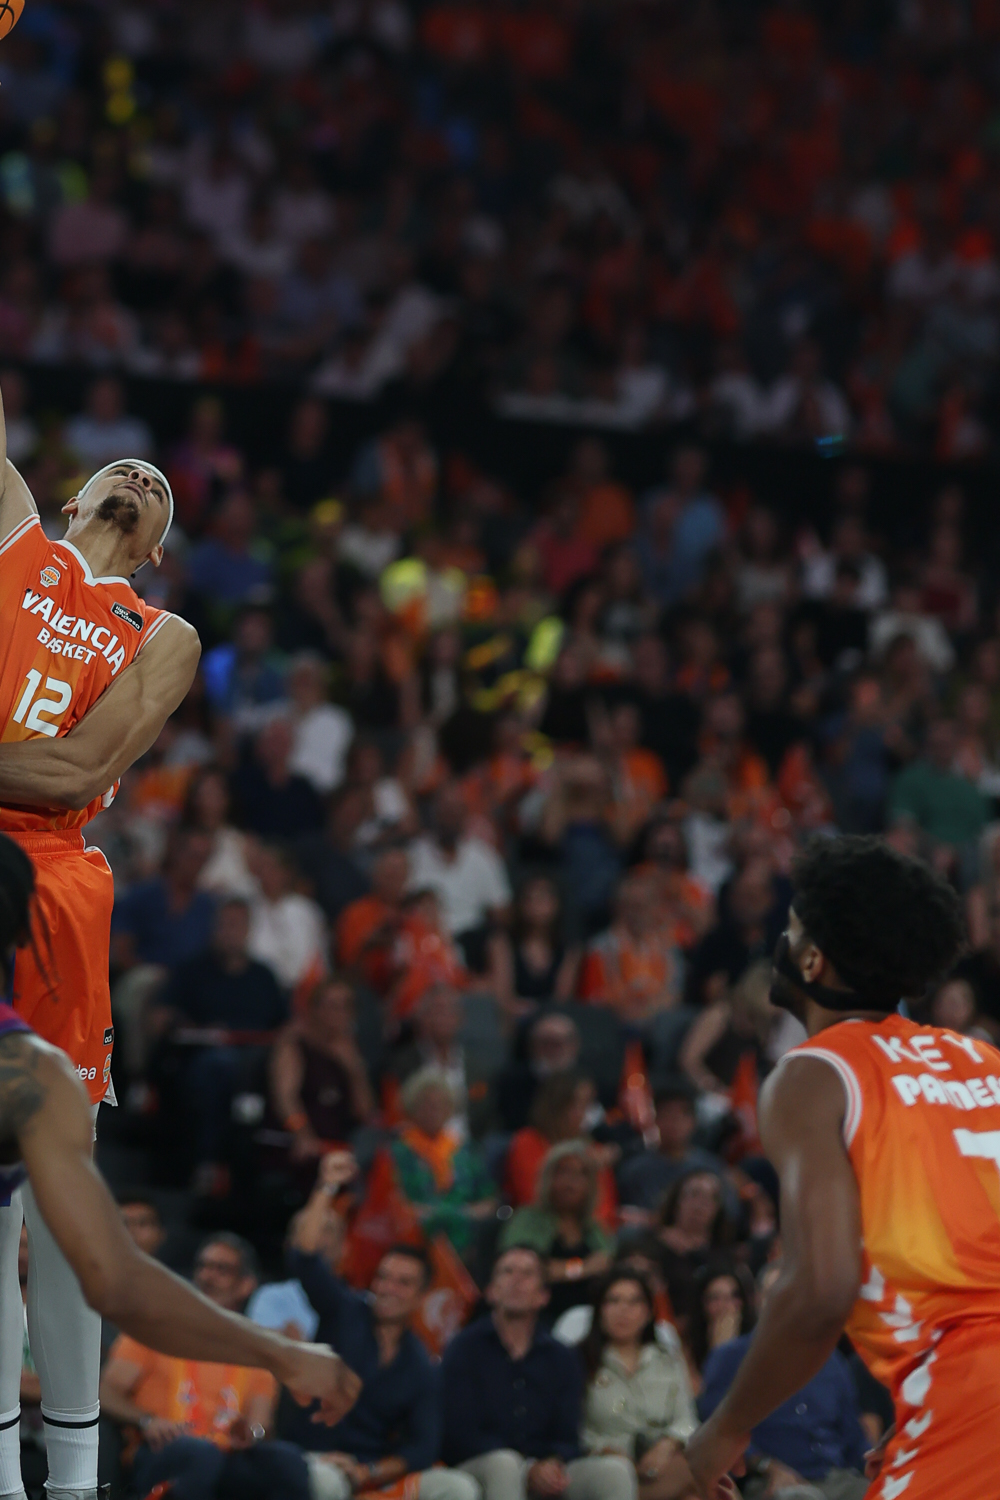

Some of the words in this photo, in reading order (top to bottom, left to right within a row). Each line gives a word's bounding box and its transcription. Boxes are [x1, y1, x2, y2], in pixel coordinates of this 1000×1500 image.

[21, 588, 127, 676] VALENCIA
[36, 627, 97, 665] BASKET
[12, 668, 73, 738] 12
[870, 1034, 984, 1071] KEY
